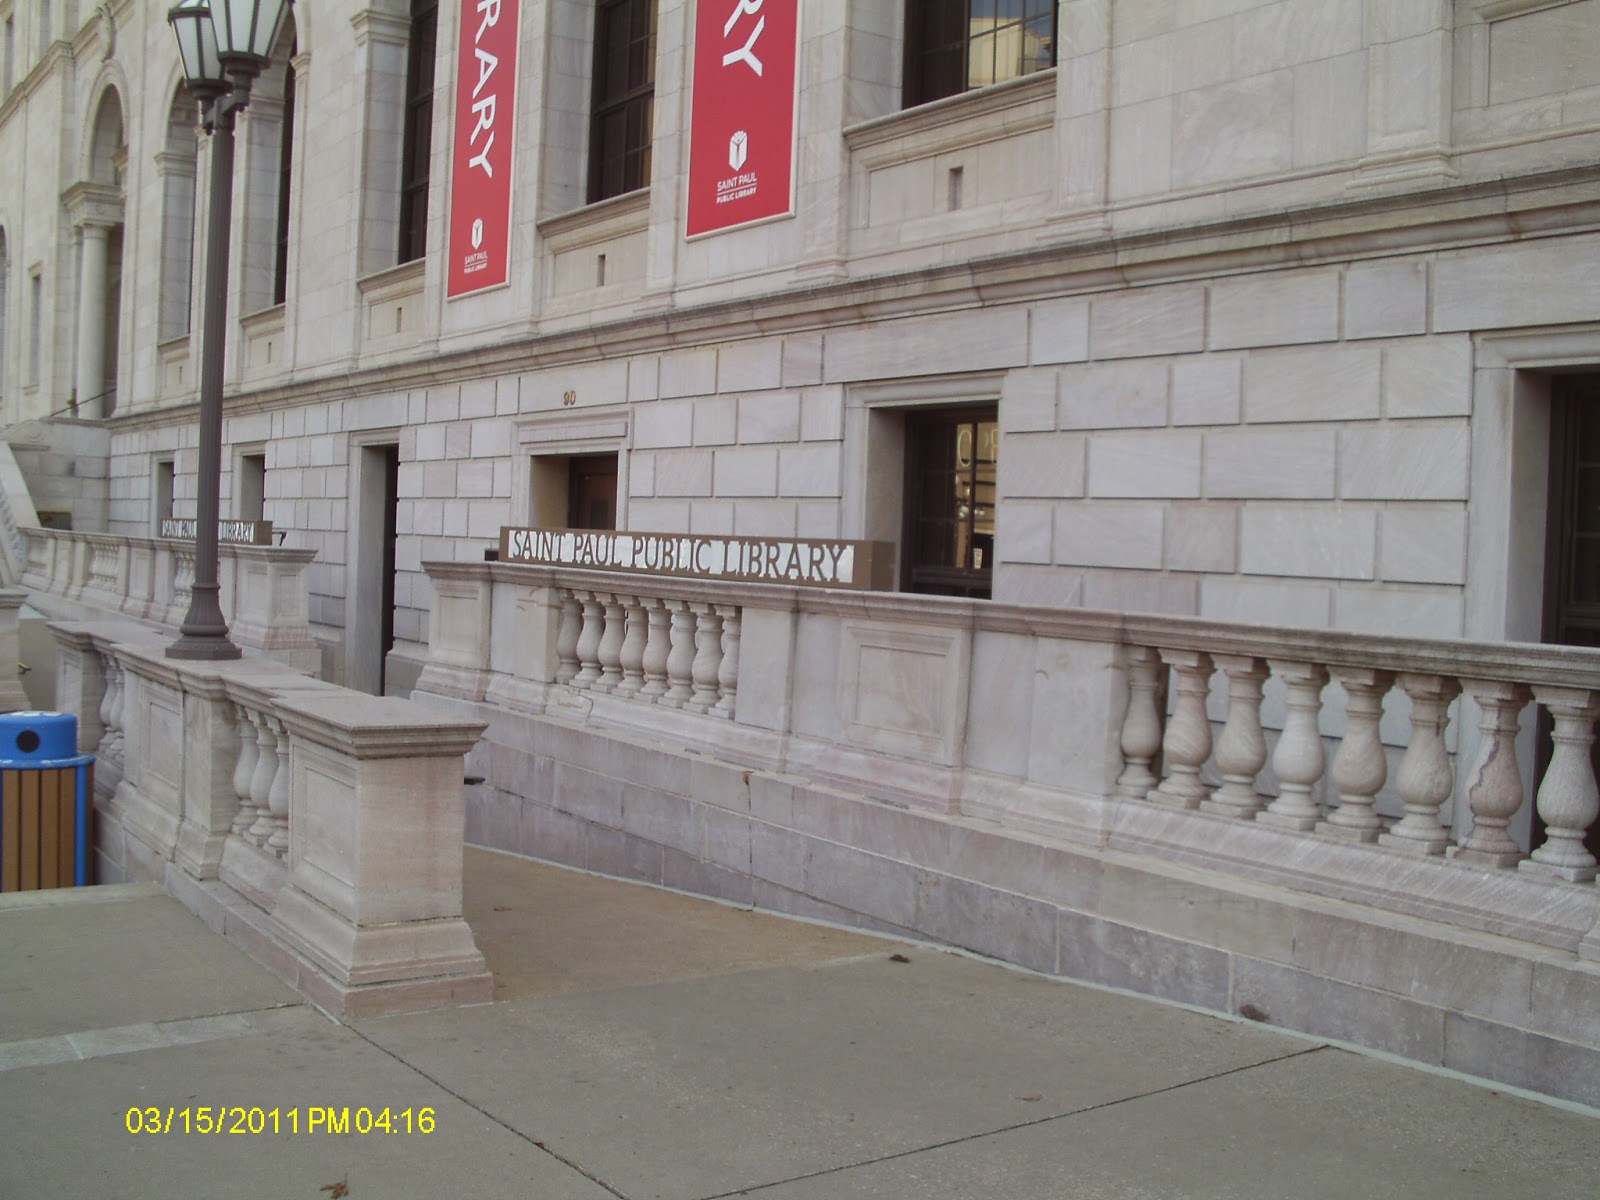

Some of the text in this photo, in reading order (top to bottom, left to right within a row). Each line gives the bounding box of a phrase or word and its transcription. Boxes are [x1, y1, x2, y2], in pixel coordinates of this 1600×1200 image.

[469, 0, 501, 178] RARY
[717, 172, 757, 192] SAINT PAUL
[513, 530, 845, 582] SAINT PAUL PUBLIC LIBRARY
